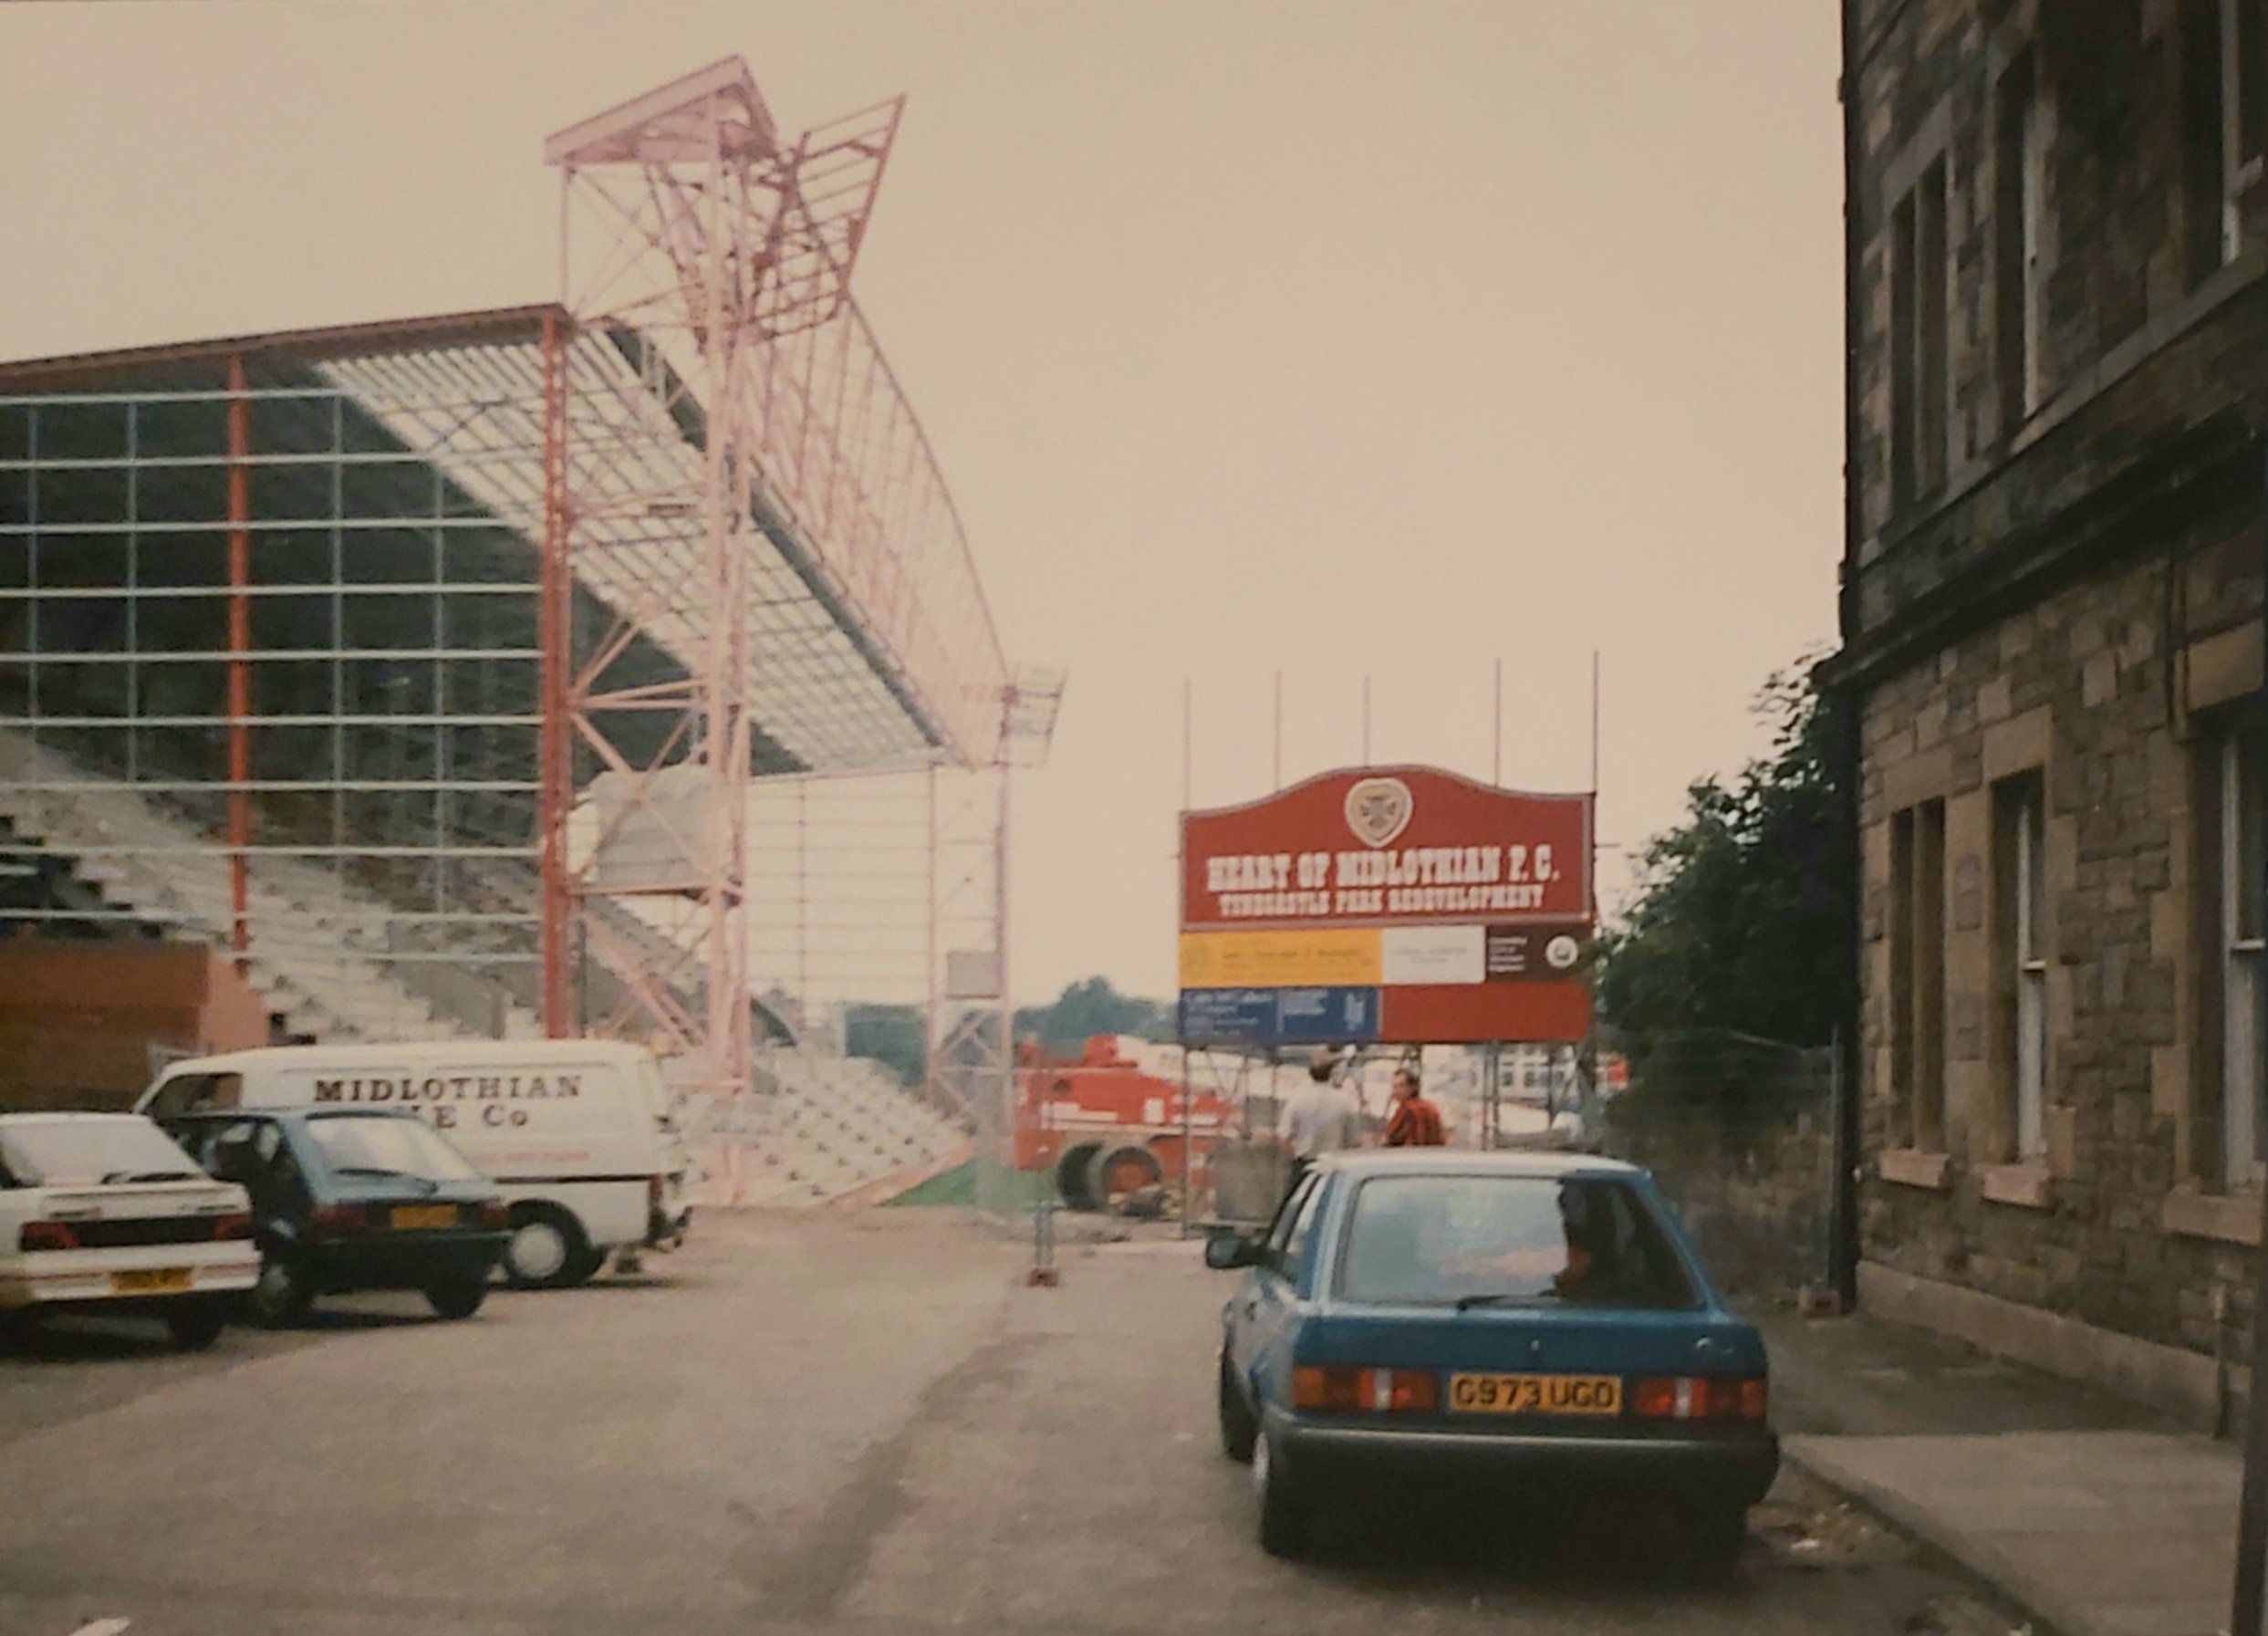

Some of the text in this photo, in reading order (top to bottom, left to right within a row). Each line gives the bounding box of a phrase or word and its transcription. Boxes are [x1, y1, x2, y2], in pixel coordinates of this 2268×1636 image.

[1207, 854, 1291, 891] HEART
[1297, 851, 1330, 888] OF
[1336, 846, 1501, 887] MIDLOTHIAN
[315, 1076, 581, 1102] MIDLOTHIAN
[483, 1105, 528, 1127] Co
